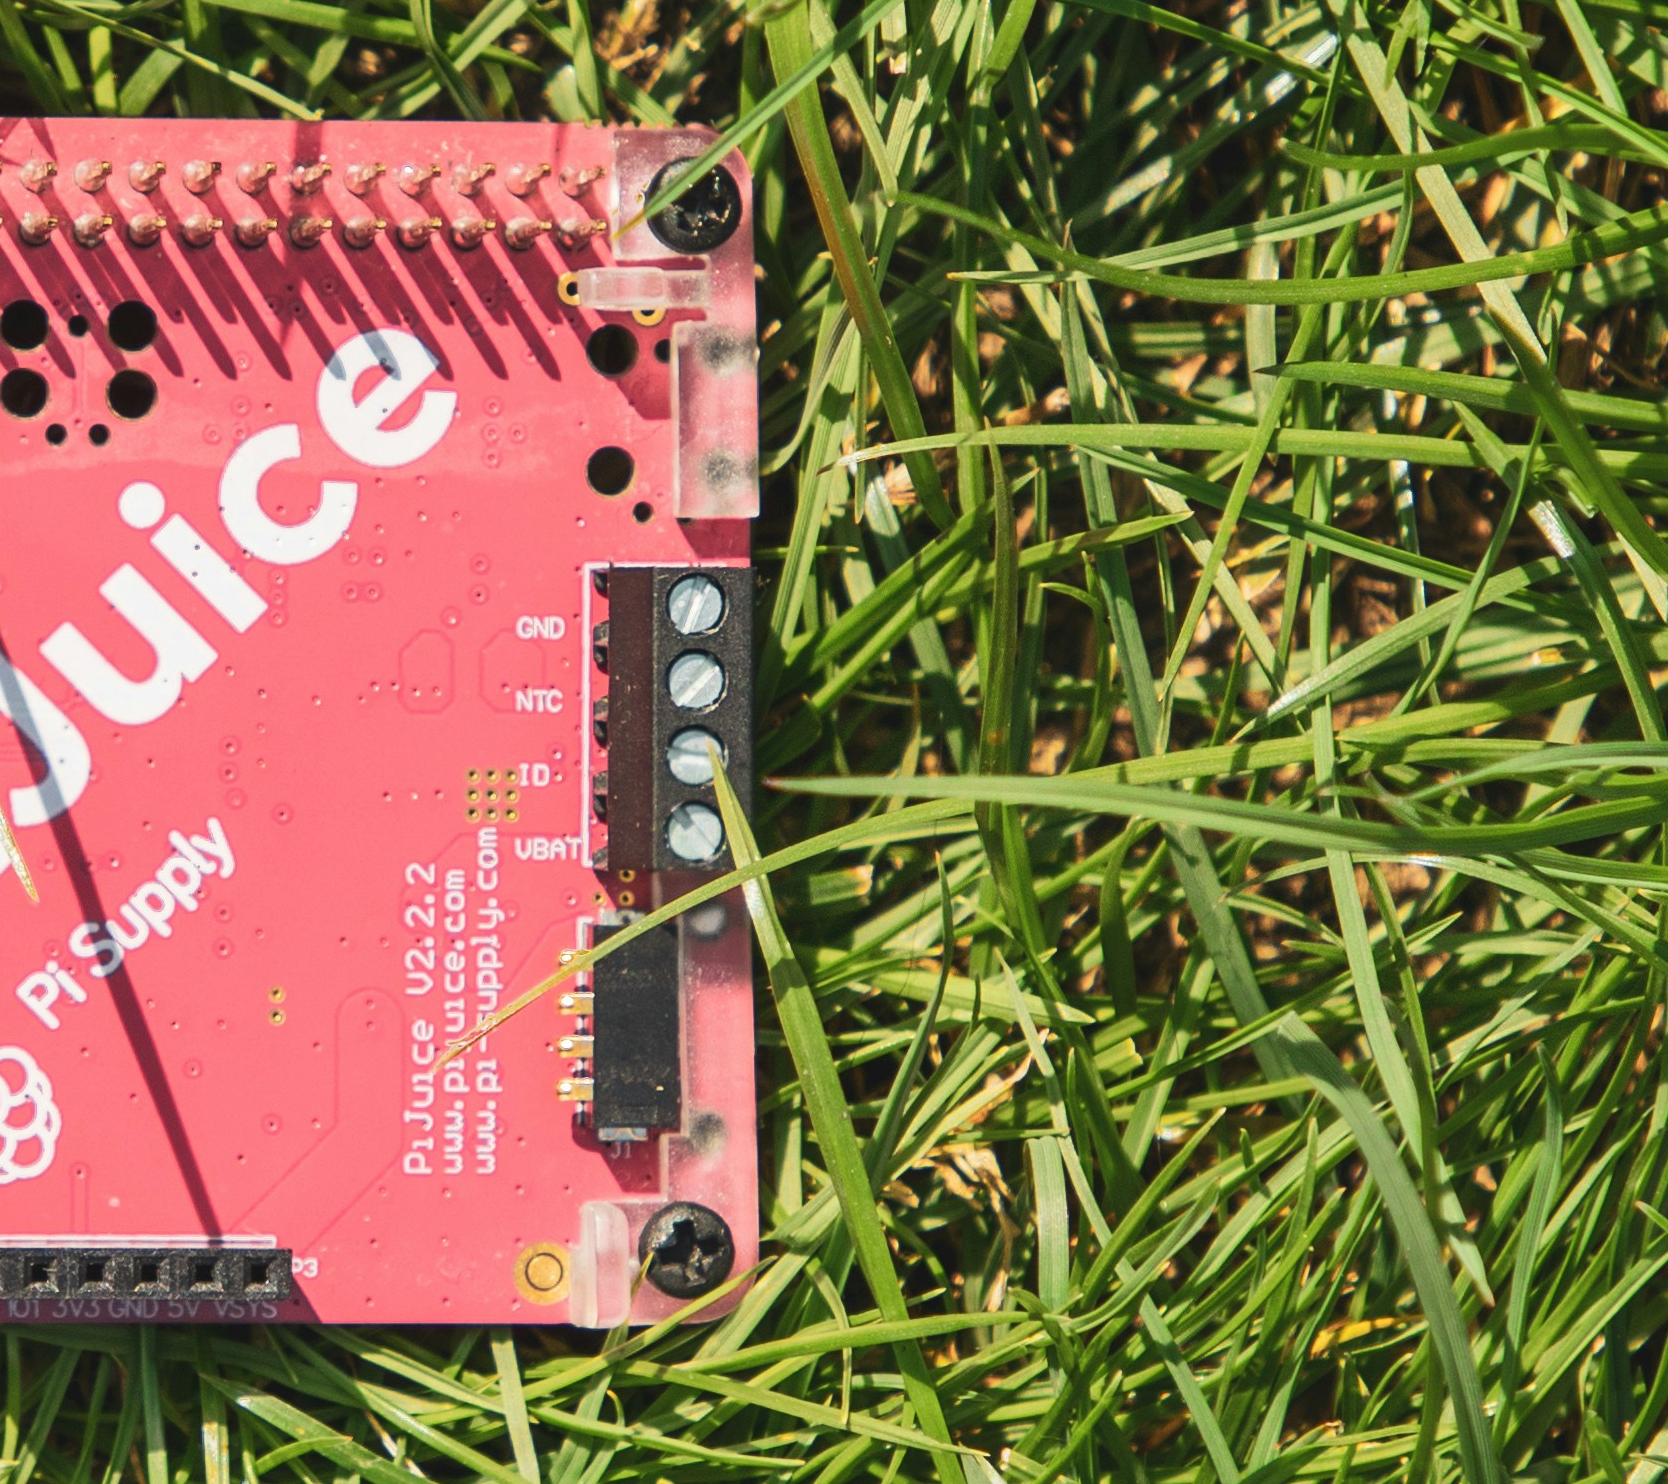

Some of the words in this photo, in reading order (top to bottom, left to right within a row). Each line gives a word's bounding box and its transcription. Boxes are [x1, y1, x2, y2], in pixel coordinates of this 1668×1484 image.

[515, 615, 567, 641] GND
[514, 688, 564, 713] NTC
[518, 763, 551, 787] ID
[514, 836, 583, 862] VBAT
[15, 959, 88, 1031] Pi
[67, 815, 236, 978] Supply
[404, 861, 436, 995] V2.2.2
[403, 1018, 435, 1176] PiJuice
